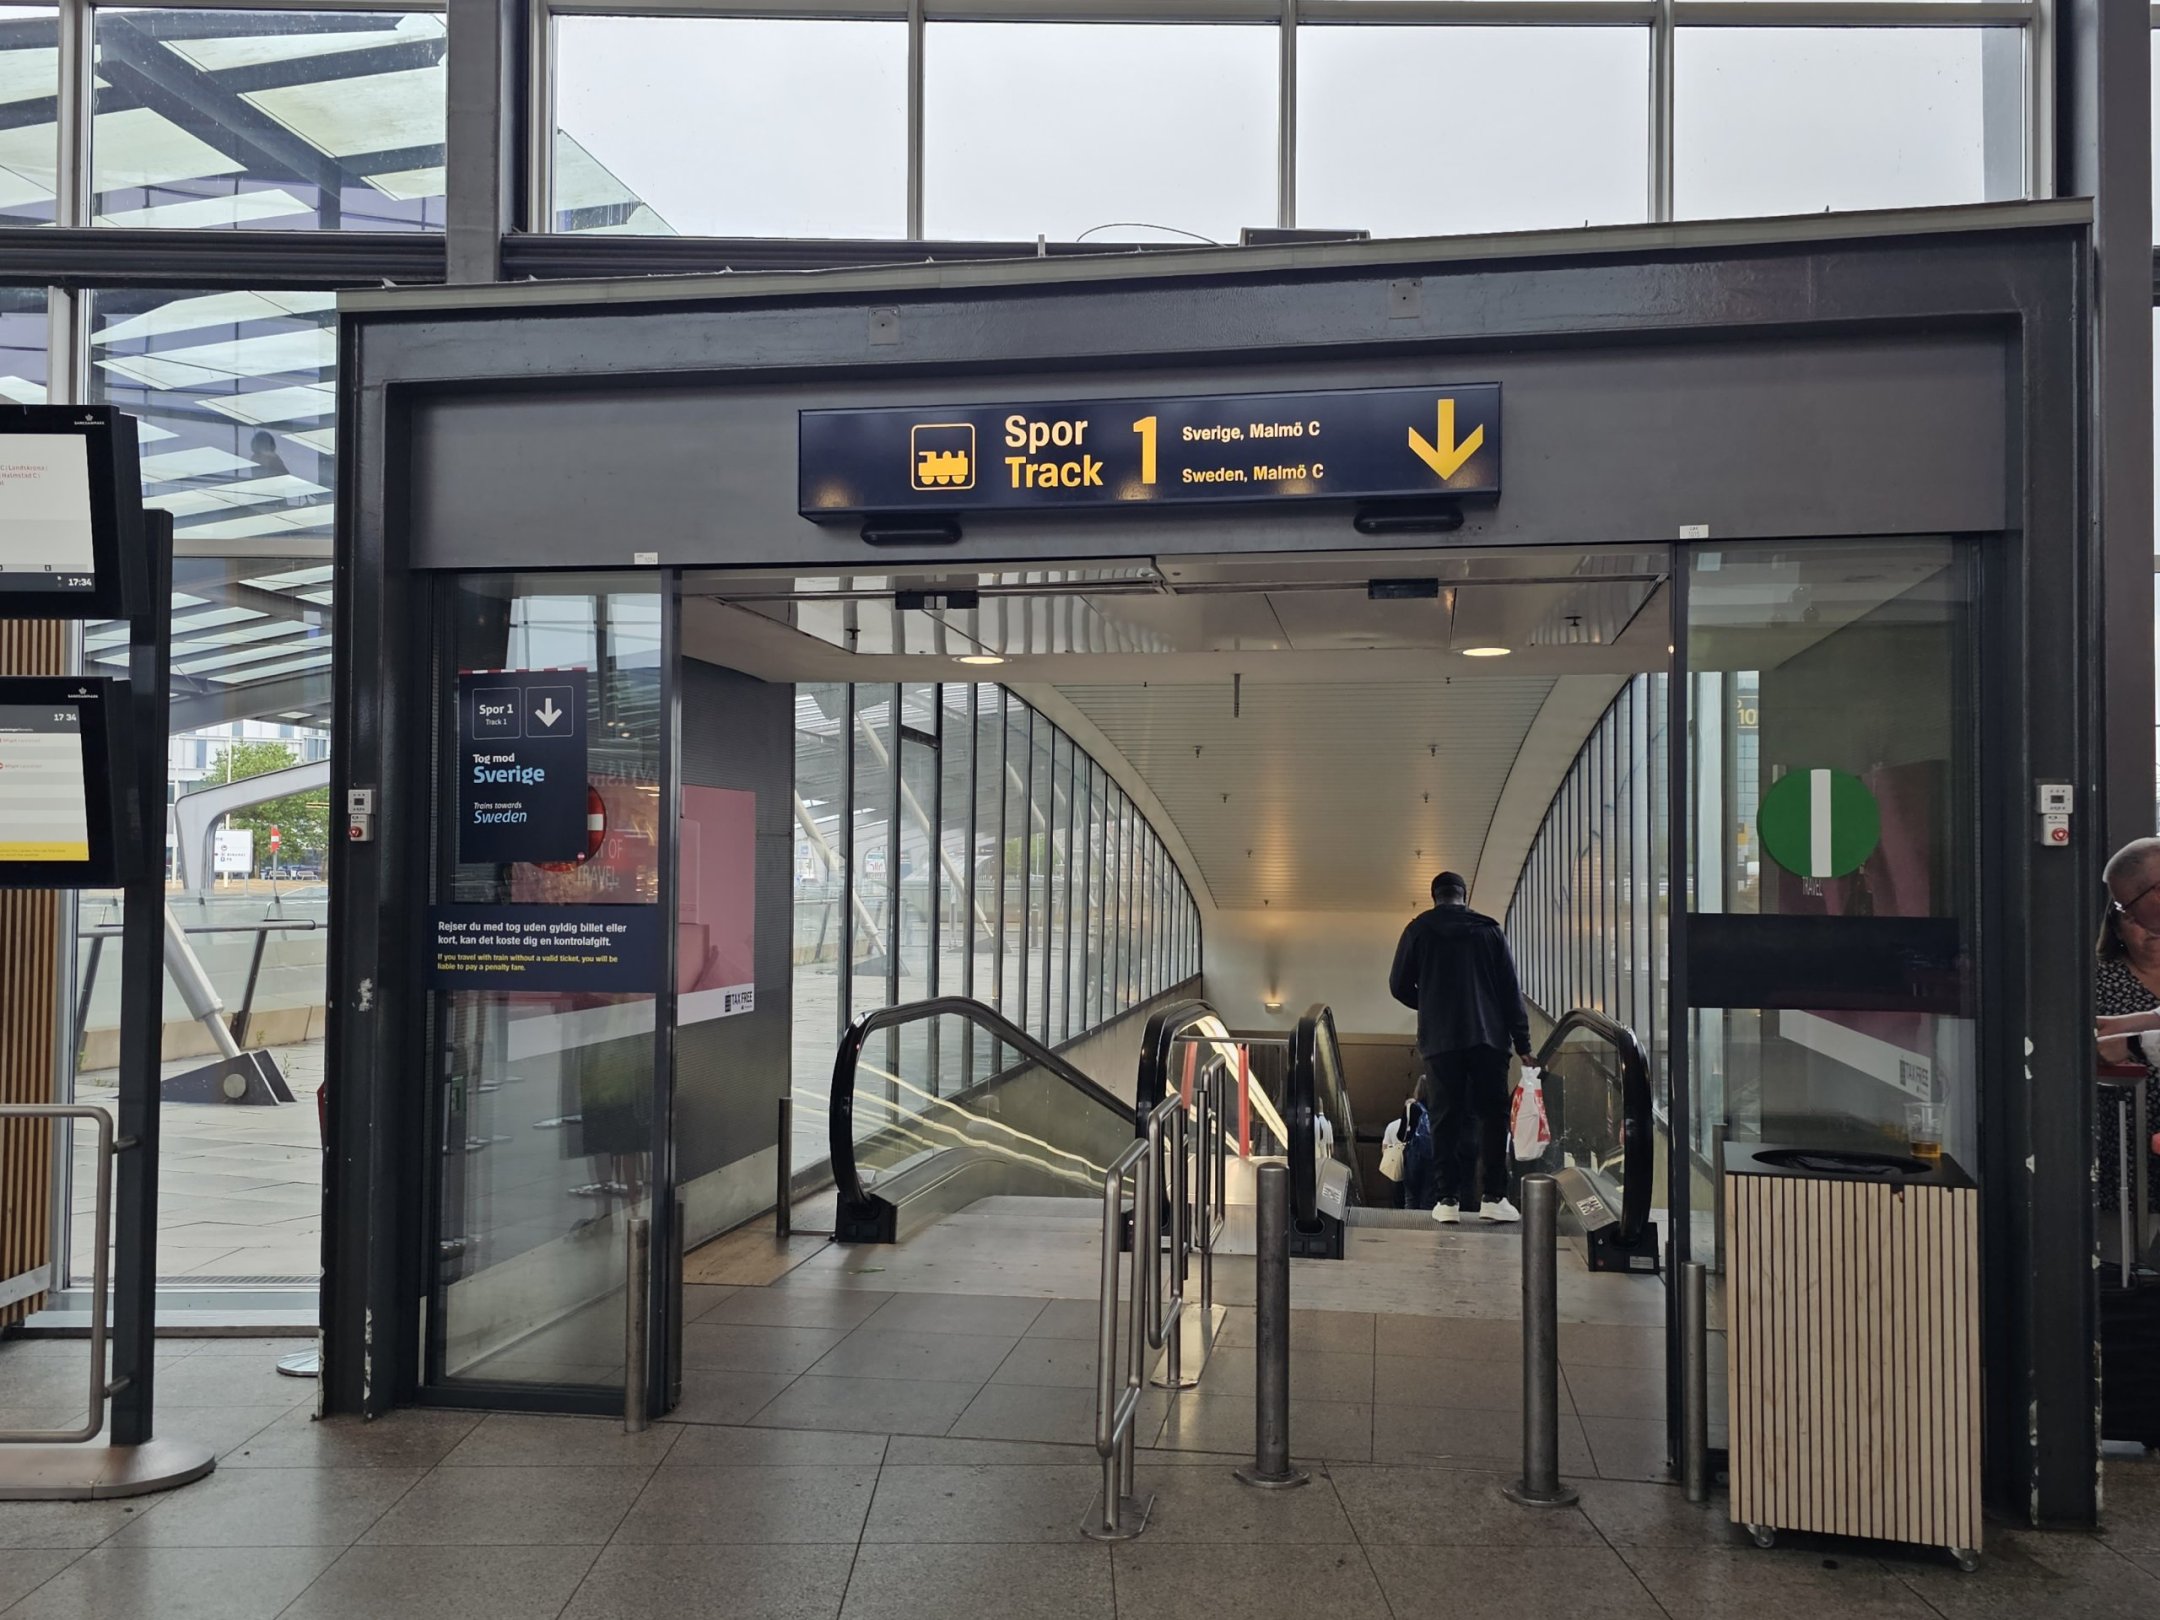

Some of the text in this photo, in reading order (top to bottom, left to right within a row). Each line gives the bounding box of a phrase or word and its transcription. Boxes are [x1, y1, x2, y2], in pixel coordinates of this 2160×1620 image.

[1005, 415, 1088, 454] Spor
[1182, 421, 1320, 442] Sverige, Malmö C
[1133, 416, 1157, 485] 1
[1005, 454, 1104, 488] Track
[1182, 464, 1324, 483] Sweden, Malmö C
[68, 578, 92, 586] 17:34
[479, 704, 514, 716] Spor 1
[473, 753, 515, 764] Tog mod
[473, 765, 545, 785] Sverige
[474, 810, 527, 823] Sweden
[608, 838, 624, 860] OF
[577, 865, 617, 887] TRAVEL
[438, 922, 627, 934] Rejser du med tog uden gyldig billet eller
[438, 936, 611, 947] kort, kan det koste dig en kontrolafgift.
[510, 954, 535, 962] without
[560, 955, 580, 963] ticket,
[609, 955, 618, 963] be
[465, 964, 478, 972] pay
[485, 963, 510, 972] penalty
[511, 963, 526, 971] fare.
[732, 991, 752, 1004] TAX FREE
